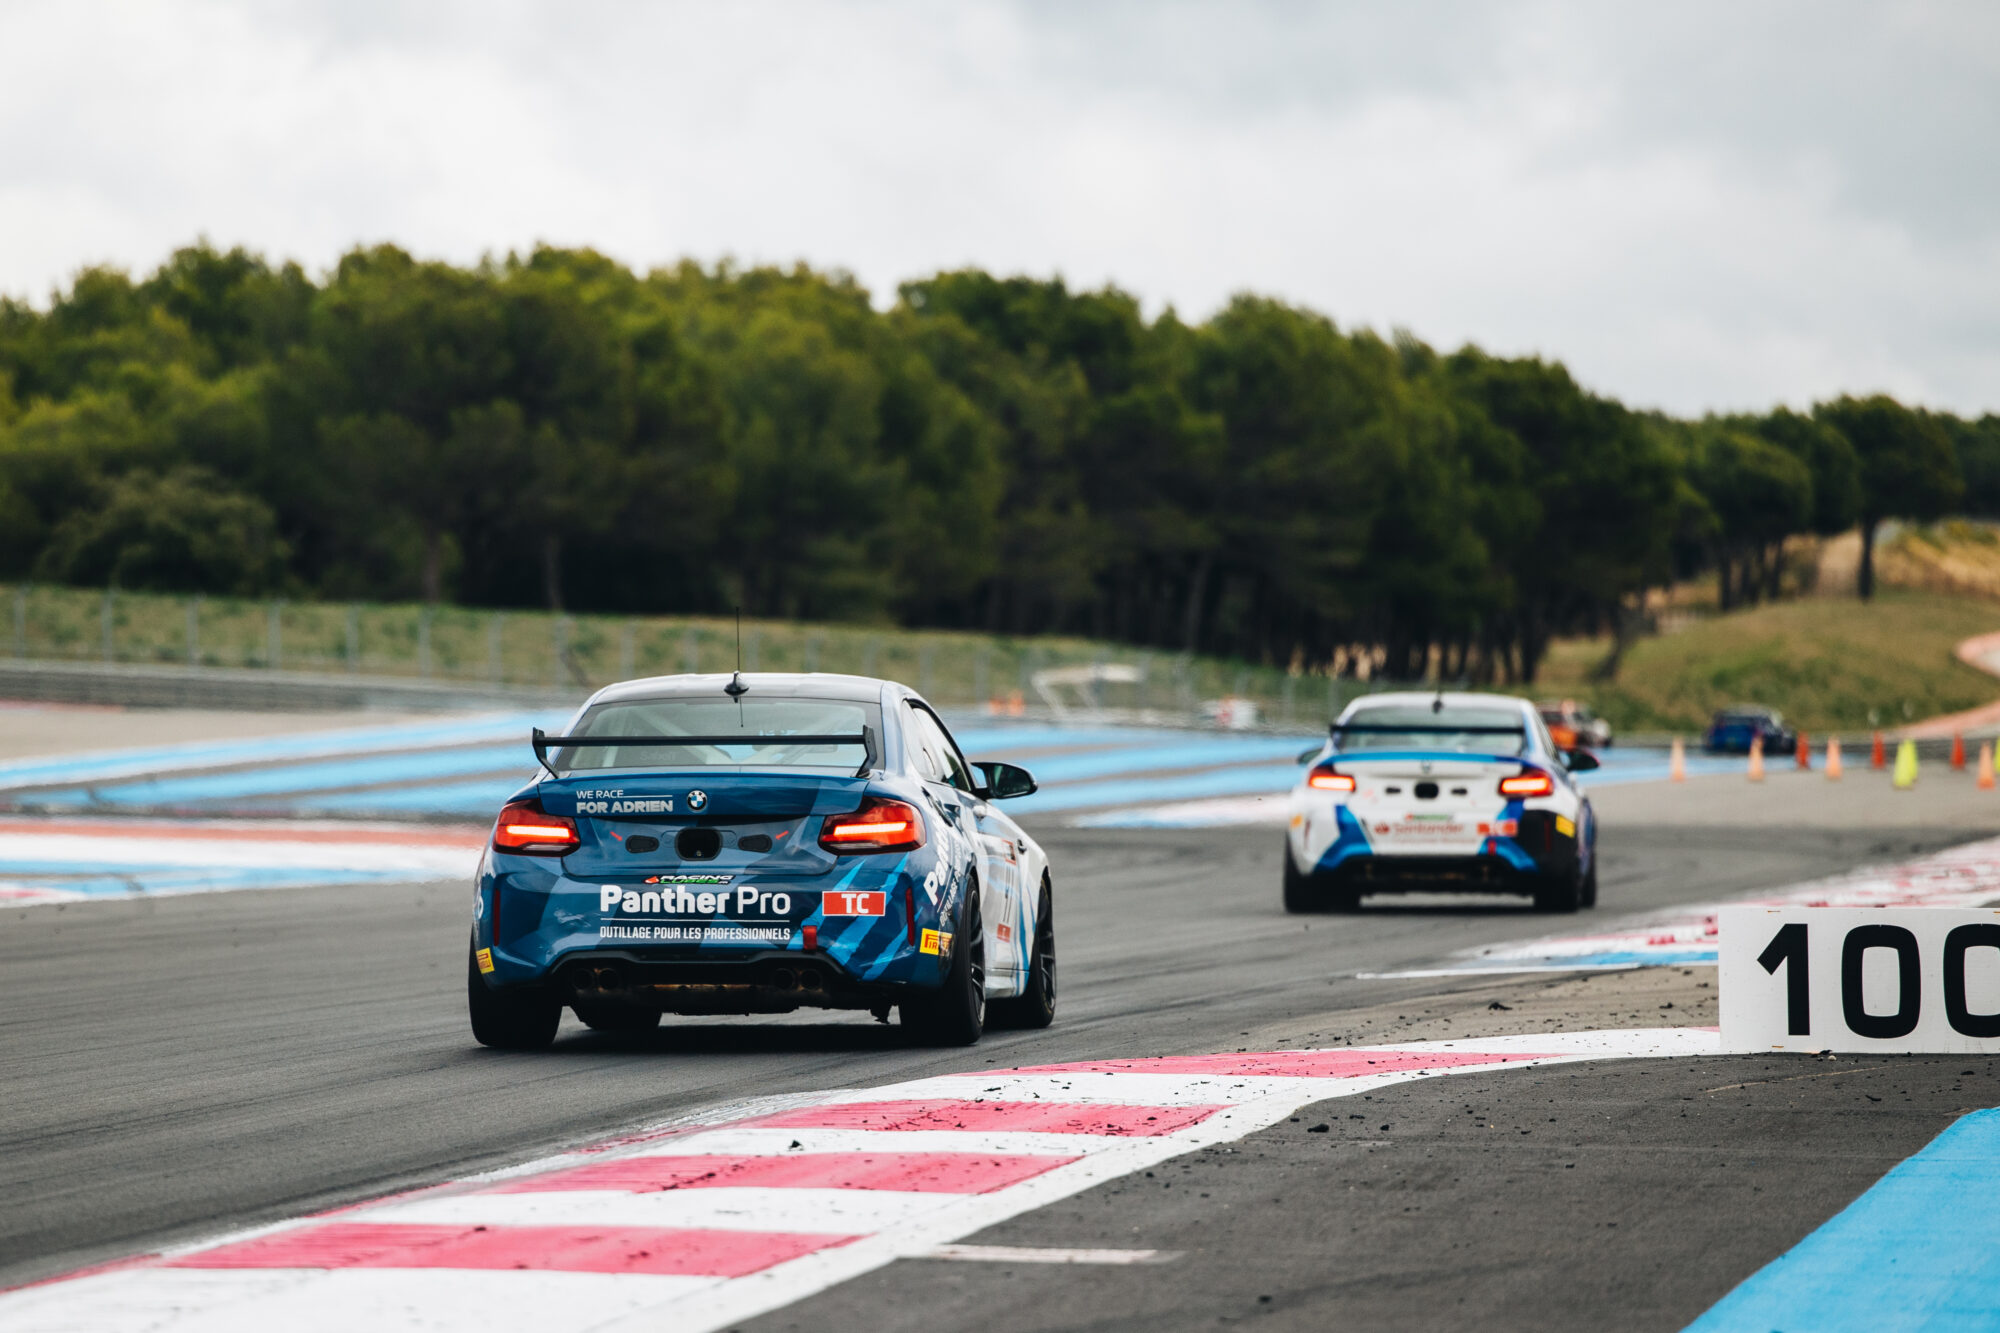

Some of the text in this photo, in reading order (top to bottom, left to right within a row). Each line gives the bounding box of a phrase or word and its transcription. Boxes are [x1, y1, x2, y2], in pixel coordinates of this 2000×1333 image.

[576, 790, 624, 799] WE RACE
[576, 800, 673, 814] FOR ADRIEN
[601, 885, 791, 915] Panther Pro
[841, 893, 870, 914] TC
[600, 926, 791, 941] OUTILLAGE POUR LES PROFESSIONNELS
[1757, 923, 2000, 1039] 100
